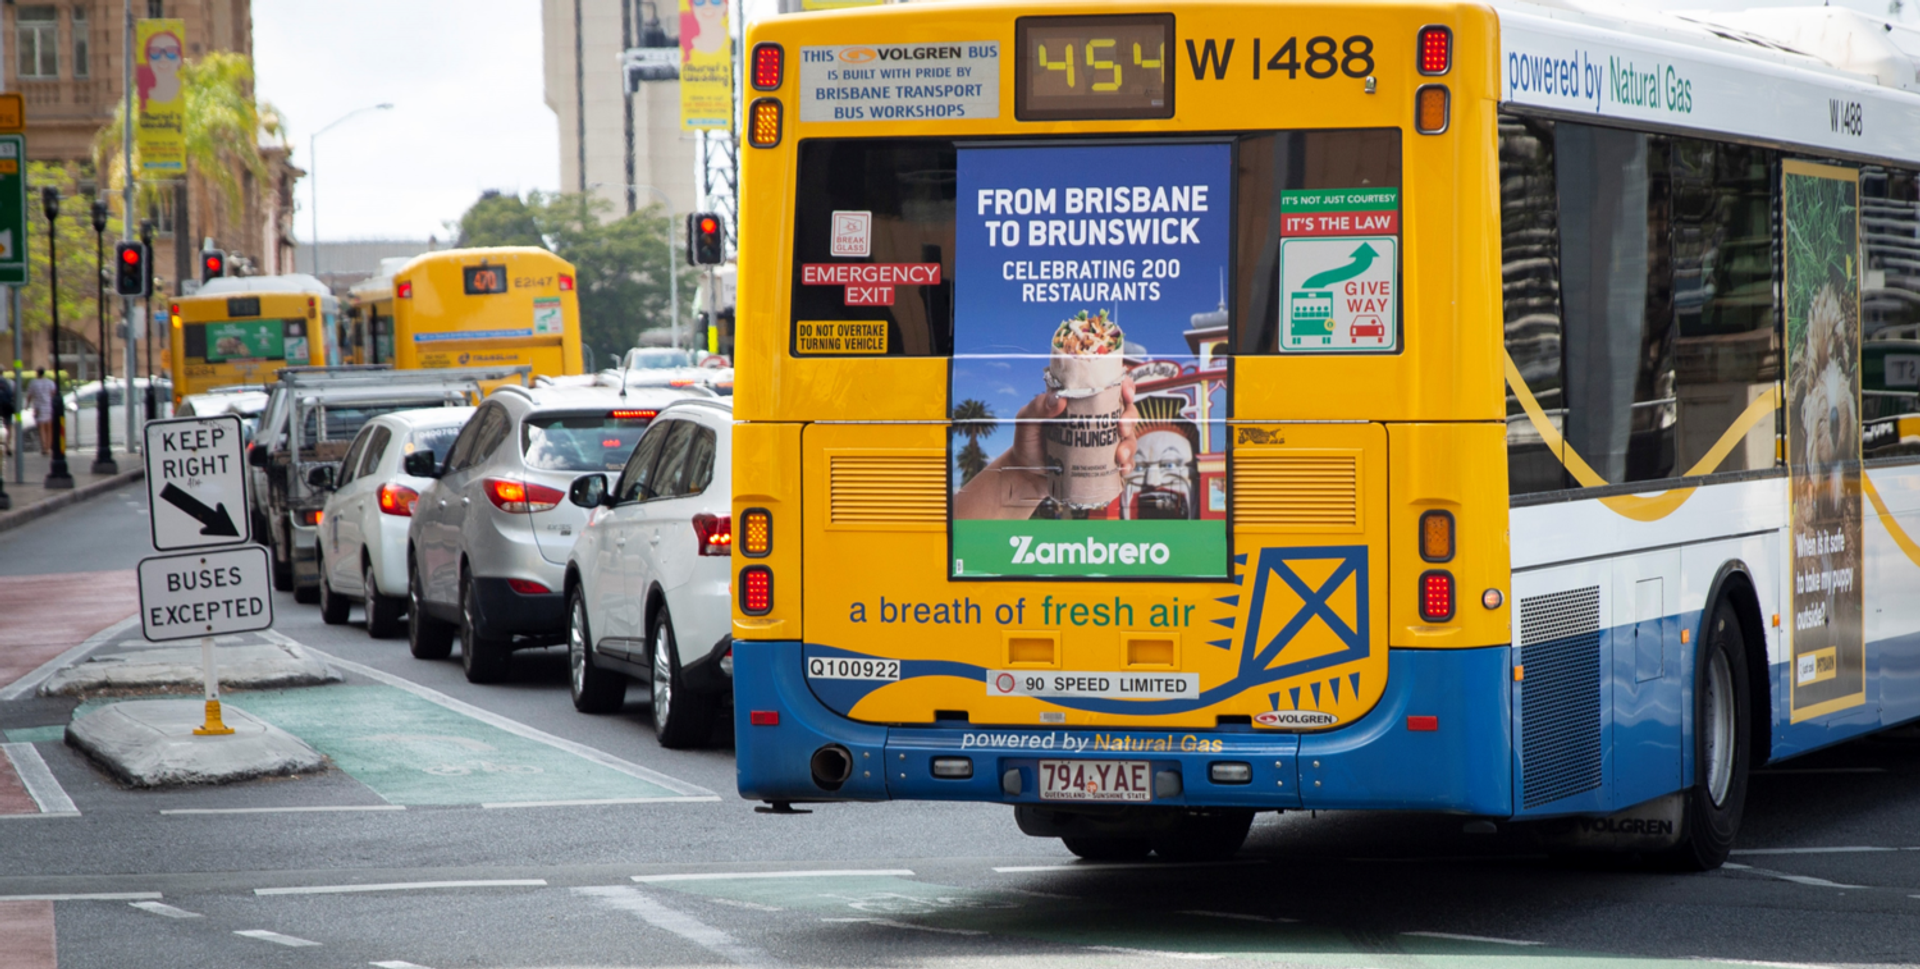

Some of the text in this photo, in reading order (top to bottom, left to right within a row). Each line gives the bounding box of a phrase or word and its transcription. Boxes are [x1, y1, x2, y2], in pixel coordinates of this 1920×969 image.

[803, 46, 998, 62] THIS VOLGREN BUS
[1185, 35, 1375, 81] W 1488
[828, 67, 972, 80] IS BUILT WITH PRIDE BY
[1038, 39, 1165, 91] 454
[816, 84, 982, 100] BRISBANE TRANSPORT
[1509, 50, 1692, 114] powered by Natural Gas
[834, 104, 965, 120] BUS WORKSHOPS
[1829, 98, 1862, 137] W 1488
[978, 185, 1208, 215] FROM BRISBANE
[1282, 194, 1396, 205] IT'S NOT JUST COURTESY
[985, 217, 1200, 247] TO BRUNSWICK
[1318, 217, 1349, 230] THE
[1355, 216, 1391, 229] LAW
[804, 266, 938, 282] EMERGENCY
[1002, 258, 1180, 280] CELEBRATING 200
[474, 270, 497, 290] 470
[1344, 281, 1390, 296] GIVE
[847, 287, 892, 303] EXIT
[1022, 281, 1161, 302] RESTAURANTS
[1347, 298, 1388, 312] WAY
[800, 324, 885, 337] DO NOT OVERTAKE
[800, 338, 884, 350] TURNING VEHICLE
[163, 428, 224, 452] KEEP
[1075, 428, 1118, 447] HUNGER
[163, 454, 229, 479] RIGHT
[1009, 535, 1170, 565] Zambrero
[1796, 528, 1845, 558] When is it safe
[167, 567, 242, 592] BUSES
[1796, 567, 1854, 595] to take my puppy
[150, 597, 263, 627] EXCEPTED
[849, 595, 1196, 627] a breath of fresh air
[1797, 602, 1826, 631] outside?
[810, 659, 900, 679] Q100922
[1025, 677, 1188, 694] 90 SPEED LIMITED
[1278, 714, 1332, 724] VOLGREN
[961, 731, 1223, 753] powered by Natural Gas
[1577, 818, 1673, 836] VOLGREN
